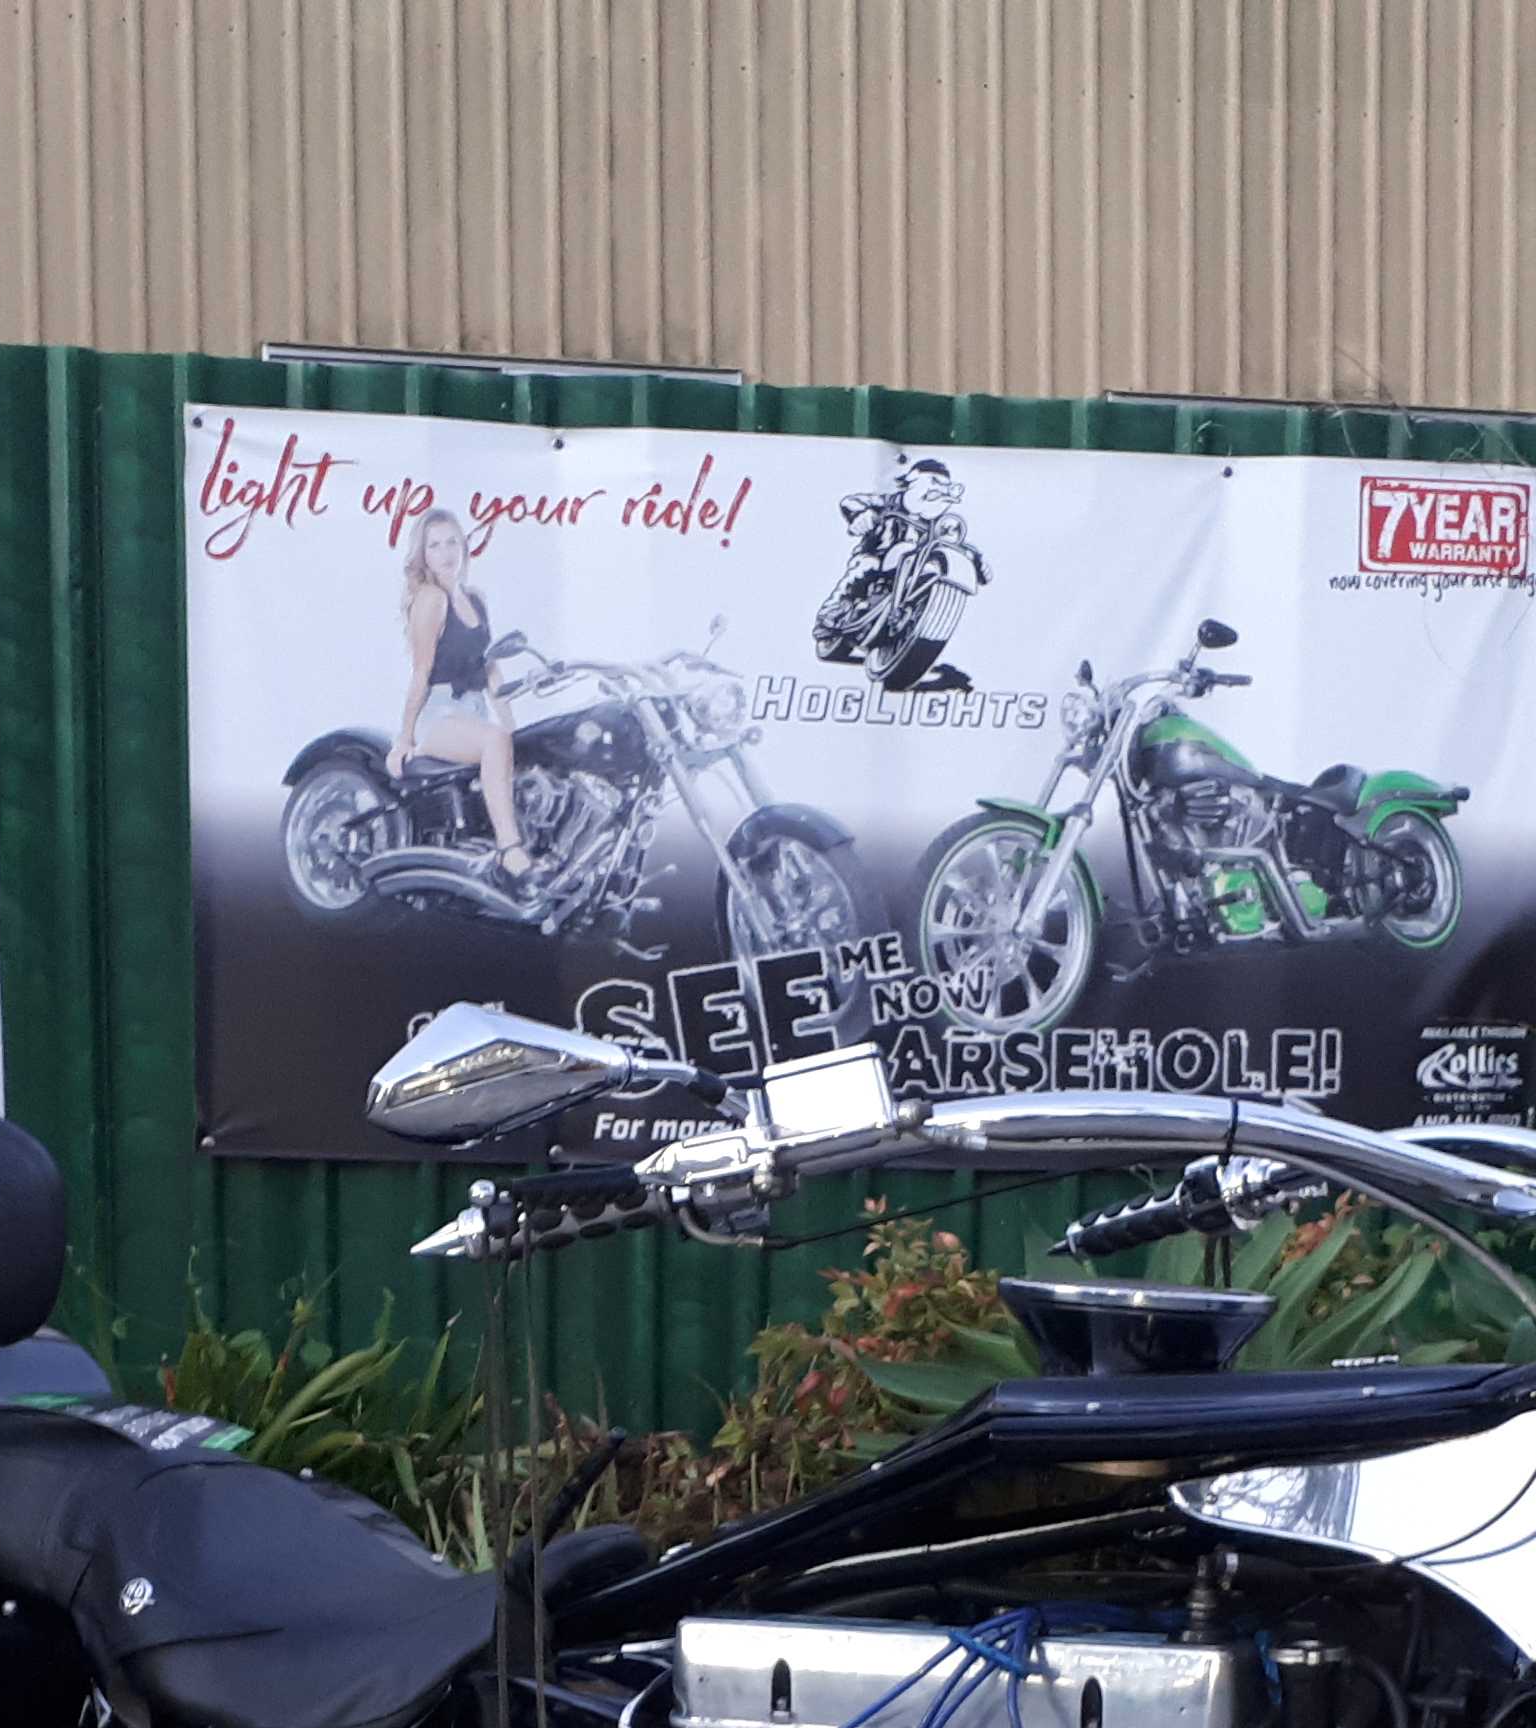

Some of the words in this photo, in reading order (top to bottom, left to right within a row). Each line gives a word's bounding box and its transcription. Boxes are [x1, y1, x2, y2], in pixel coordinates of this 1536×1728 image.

[200, 418, 356, 559] light
[364, 477, 435, 548] up
[465, 489, 607, 557] your
[621, 454, 752, 548] ride!
[1409, 540, 1518, 564] WARRANTY
[1329, 575, 1361, 590] now
[836, 932, 914, 985] ME
[873, 964, 994, 1028] NOW
[887, 1025, 1343, 1096] ARSEHOLE!
[594, 1112, 646, 1140] For
